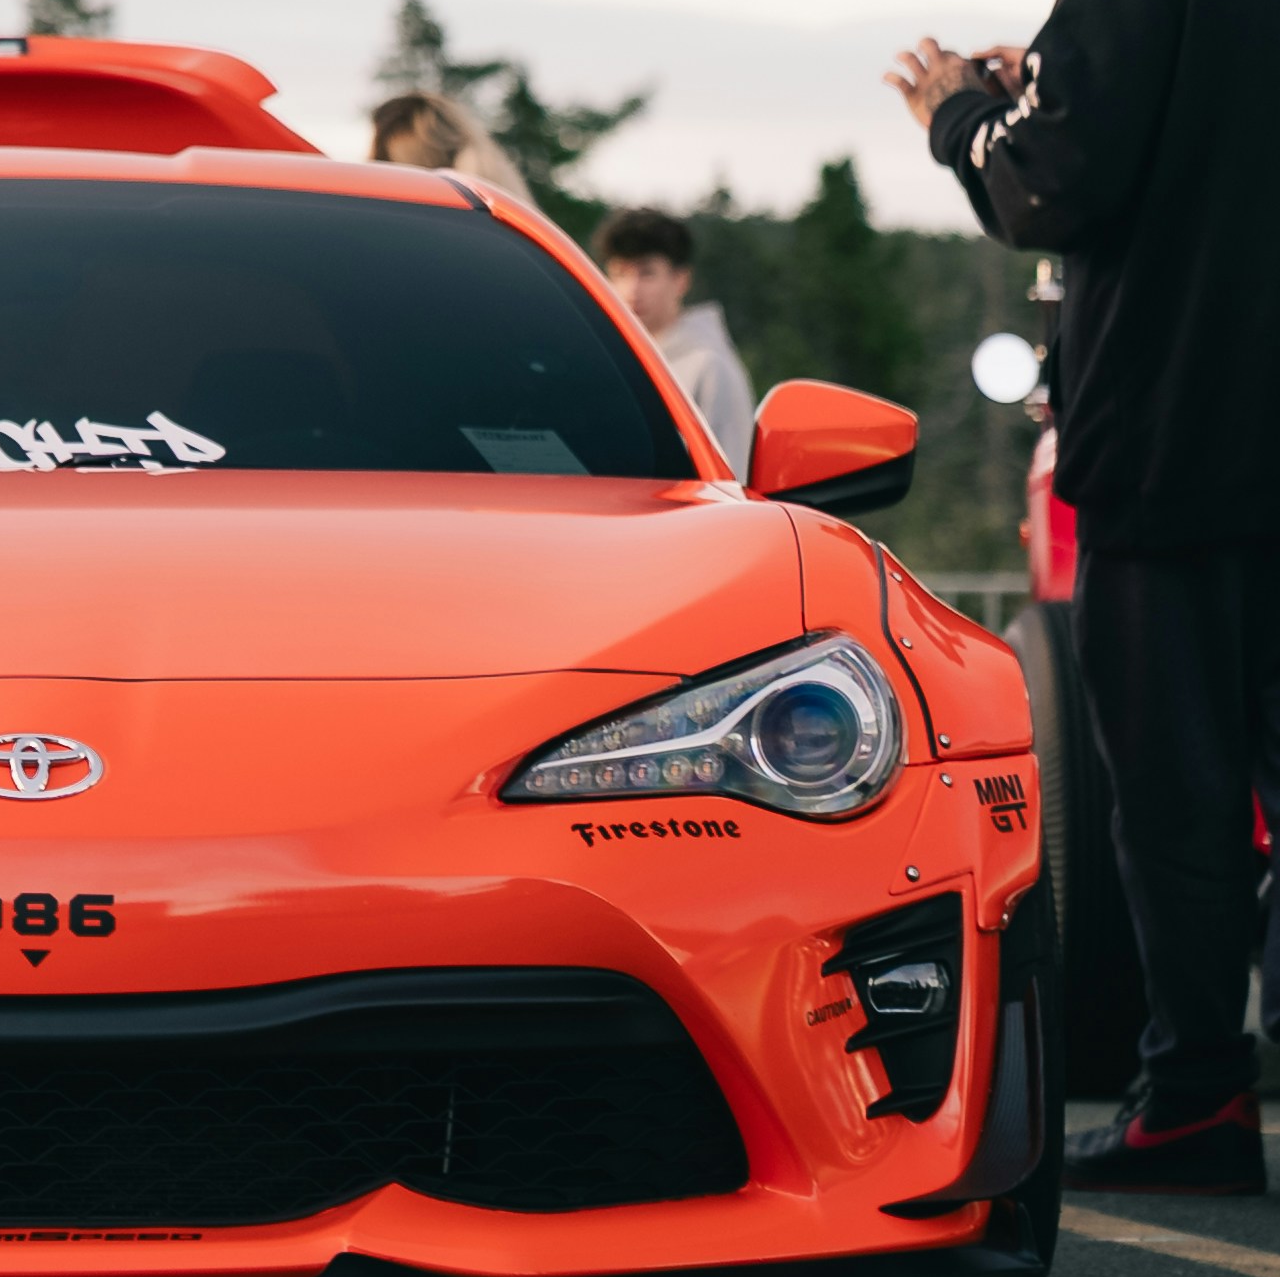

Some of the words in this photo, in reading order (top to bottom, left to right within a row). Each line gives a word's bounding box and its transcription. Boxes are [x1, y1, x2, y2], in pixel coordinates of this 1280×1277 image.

[973, 774, 1025, 805] MINI
[571, 818, 741, 847] Firestone
[990, 802, 1027, 833] GT
